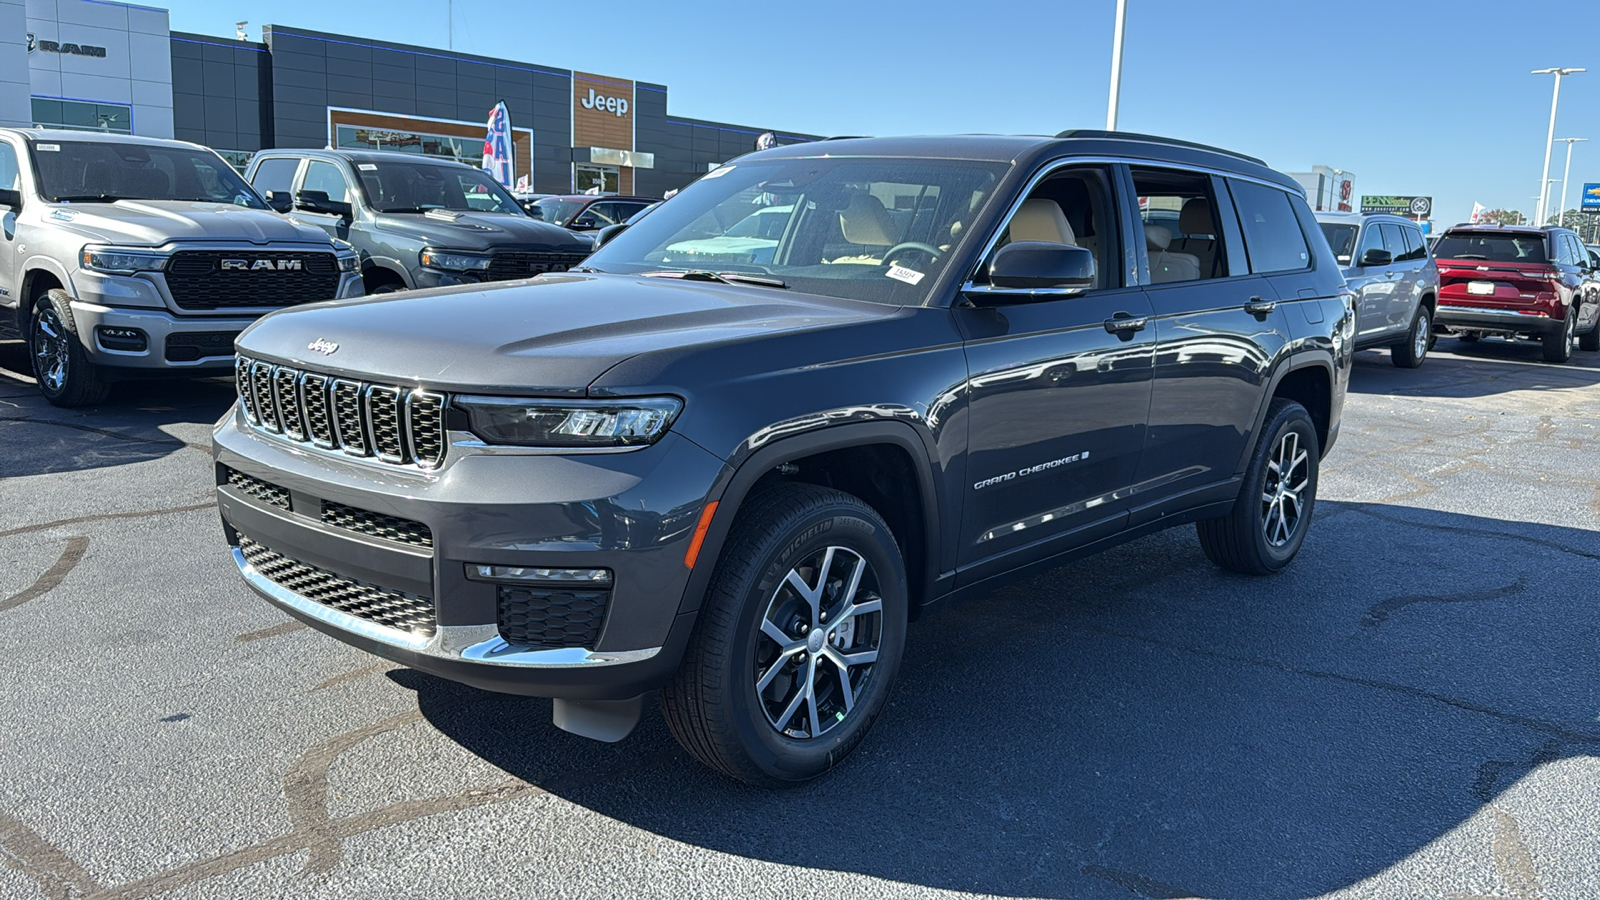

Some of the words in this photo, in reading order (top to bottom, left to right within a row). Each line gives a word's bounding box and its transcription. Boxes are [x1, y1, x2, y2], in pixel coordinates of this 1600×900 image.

[39, 40, 107, 58] RAM
[581, 88, 628, 117] Jeep
[1362, 196, 1391, 206] PENN
[221, 259, 302, 270] RAM
[529, 263, 575, 273] RA
[307, 337, 340, 356] Jeep
[974, 471, 1016, 490] GRAND
[1018, 454, 1080, 477] CHEROKEE
[781, 519, 833, 563] MICHELIN
